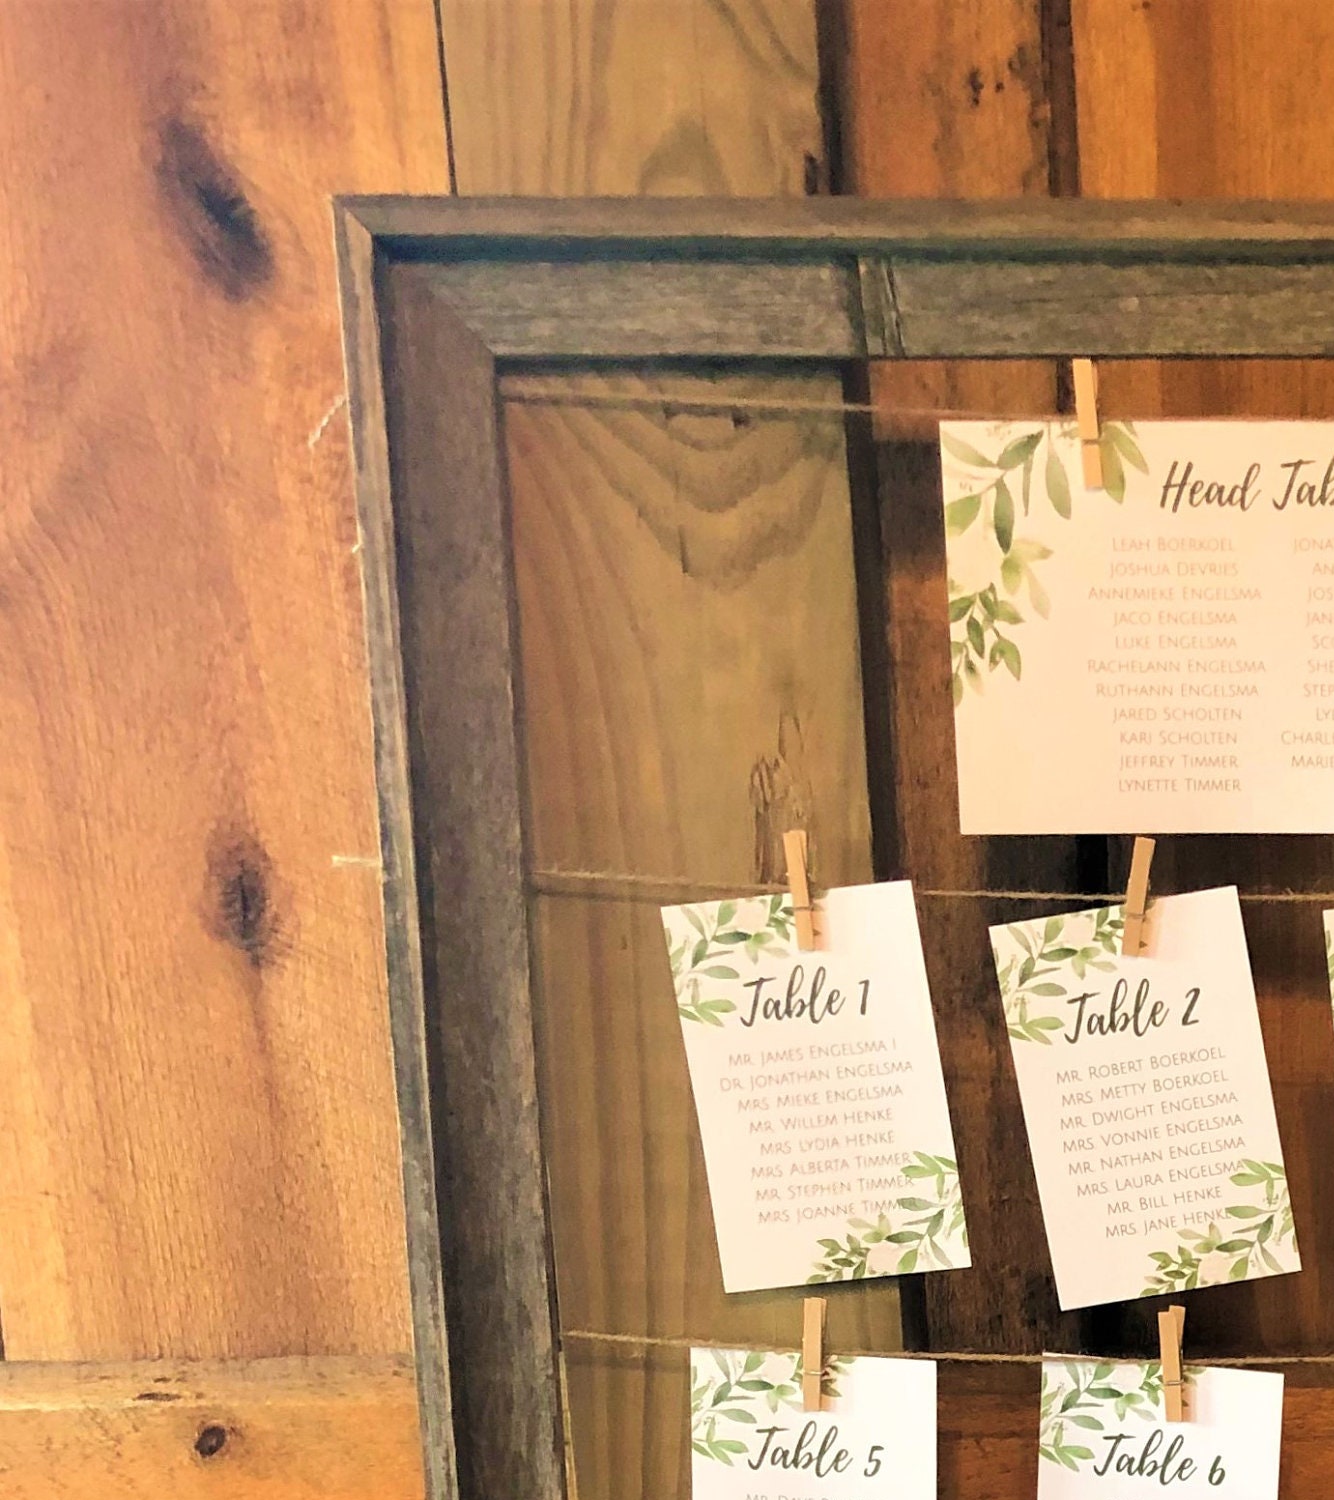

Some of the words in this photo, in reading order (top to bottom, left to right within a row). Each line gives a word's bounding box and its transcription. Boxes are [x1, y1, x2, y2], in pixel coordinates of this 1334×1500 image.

[1160, 460, 1262, 513] Head
[740, 964, 845, 1028] Table
[858, 980, 870, 1016] 1
[1064, 978, 1169, 1044] Table
[1182, 987, 1200, 1026] 2
[760, 1047, 804, 1068] JAMES
[808, 1039, 888, 1060] ENGELSMA
[1088, 1058, 1144, 1080] ROBERT
[1149, 1047, 1226, 1070] BOERKOEL
[1152, 1069, 1229, 1093] BOERKOEL
[798, 1136, 840, 1153] LYDIA
[845, 1129, 895, 1147] HENKE
[1165, 1113, 1244, 1137] ENGELSMA
[748, 1421, 852, 1476] Table
[864, 1445, 884, 1477] 5
[1093, 1429, 1196, 1484] Table
[1208, 1455, 1225, 1486] 6
